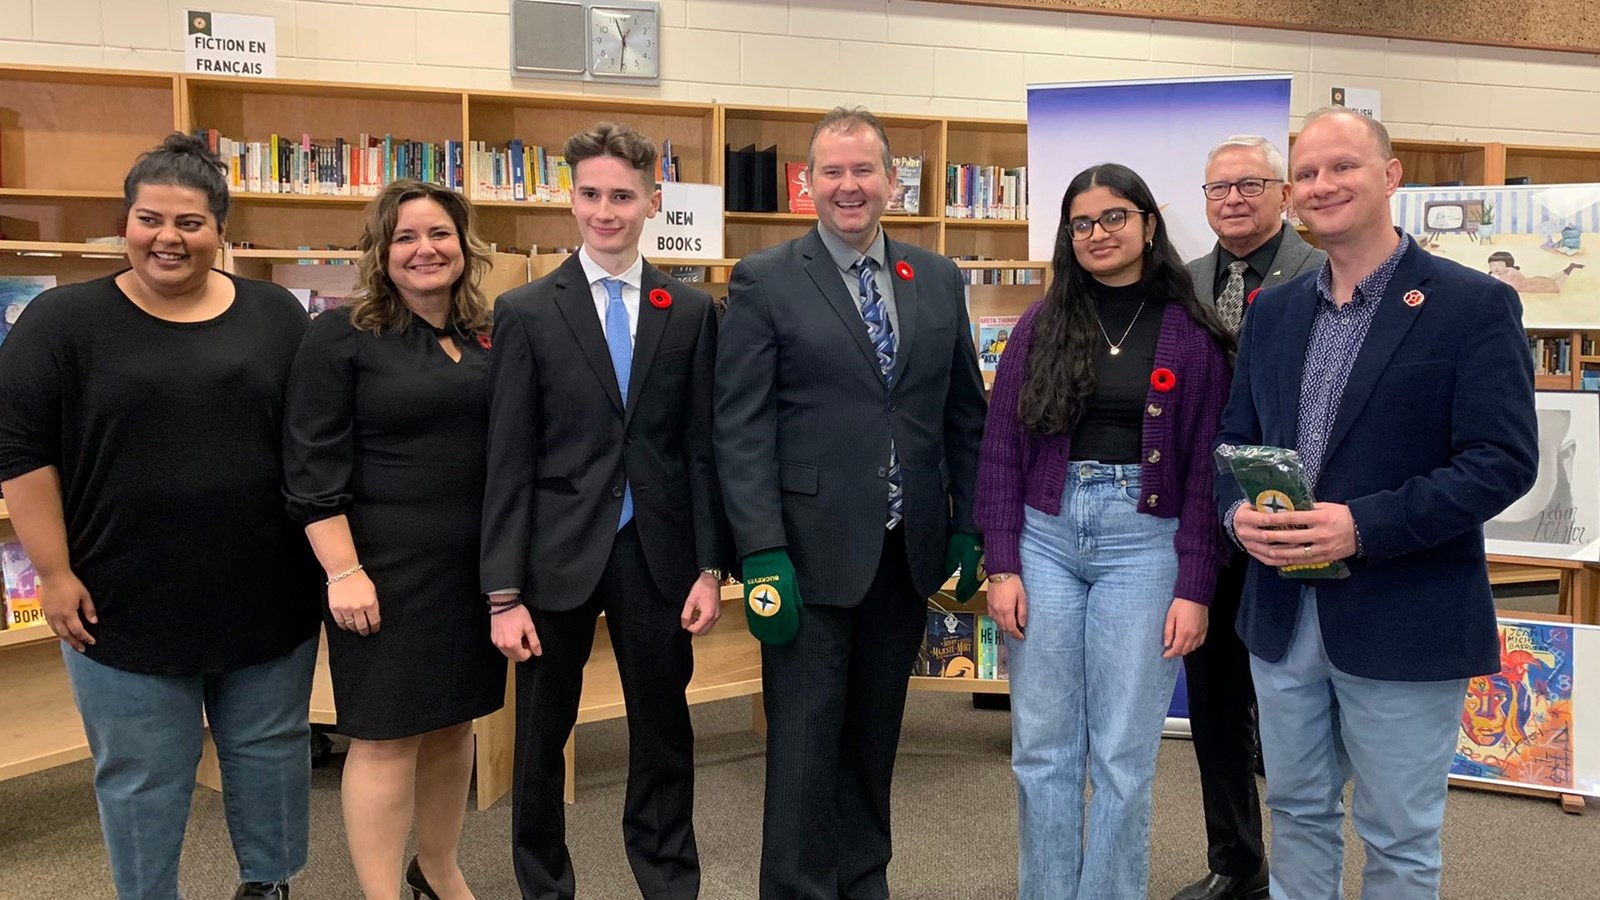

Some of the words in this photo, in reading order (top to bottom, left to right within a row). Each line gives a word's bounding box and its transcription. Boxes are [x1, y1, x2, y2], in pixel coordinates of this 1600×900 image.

[195, 36, 245, 52] FICTION
[249, 40, 266, 54] EN
[196, 58, 262, 76] FRANÇAIS
[666, 211, 693, 226] NEW
[657, 236, 702, 251] BOOKS
